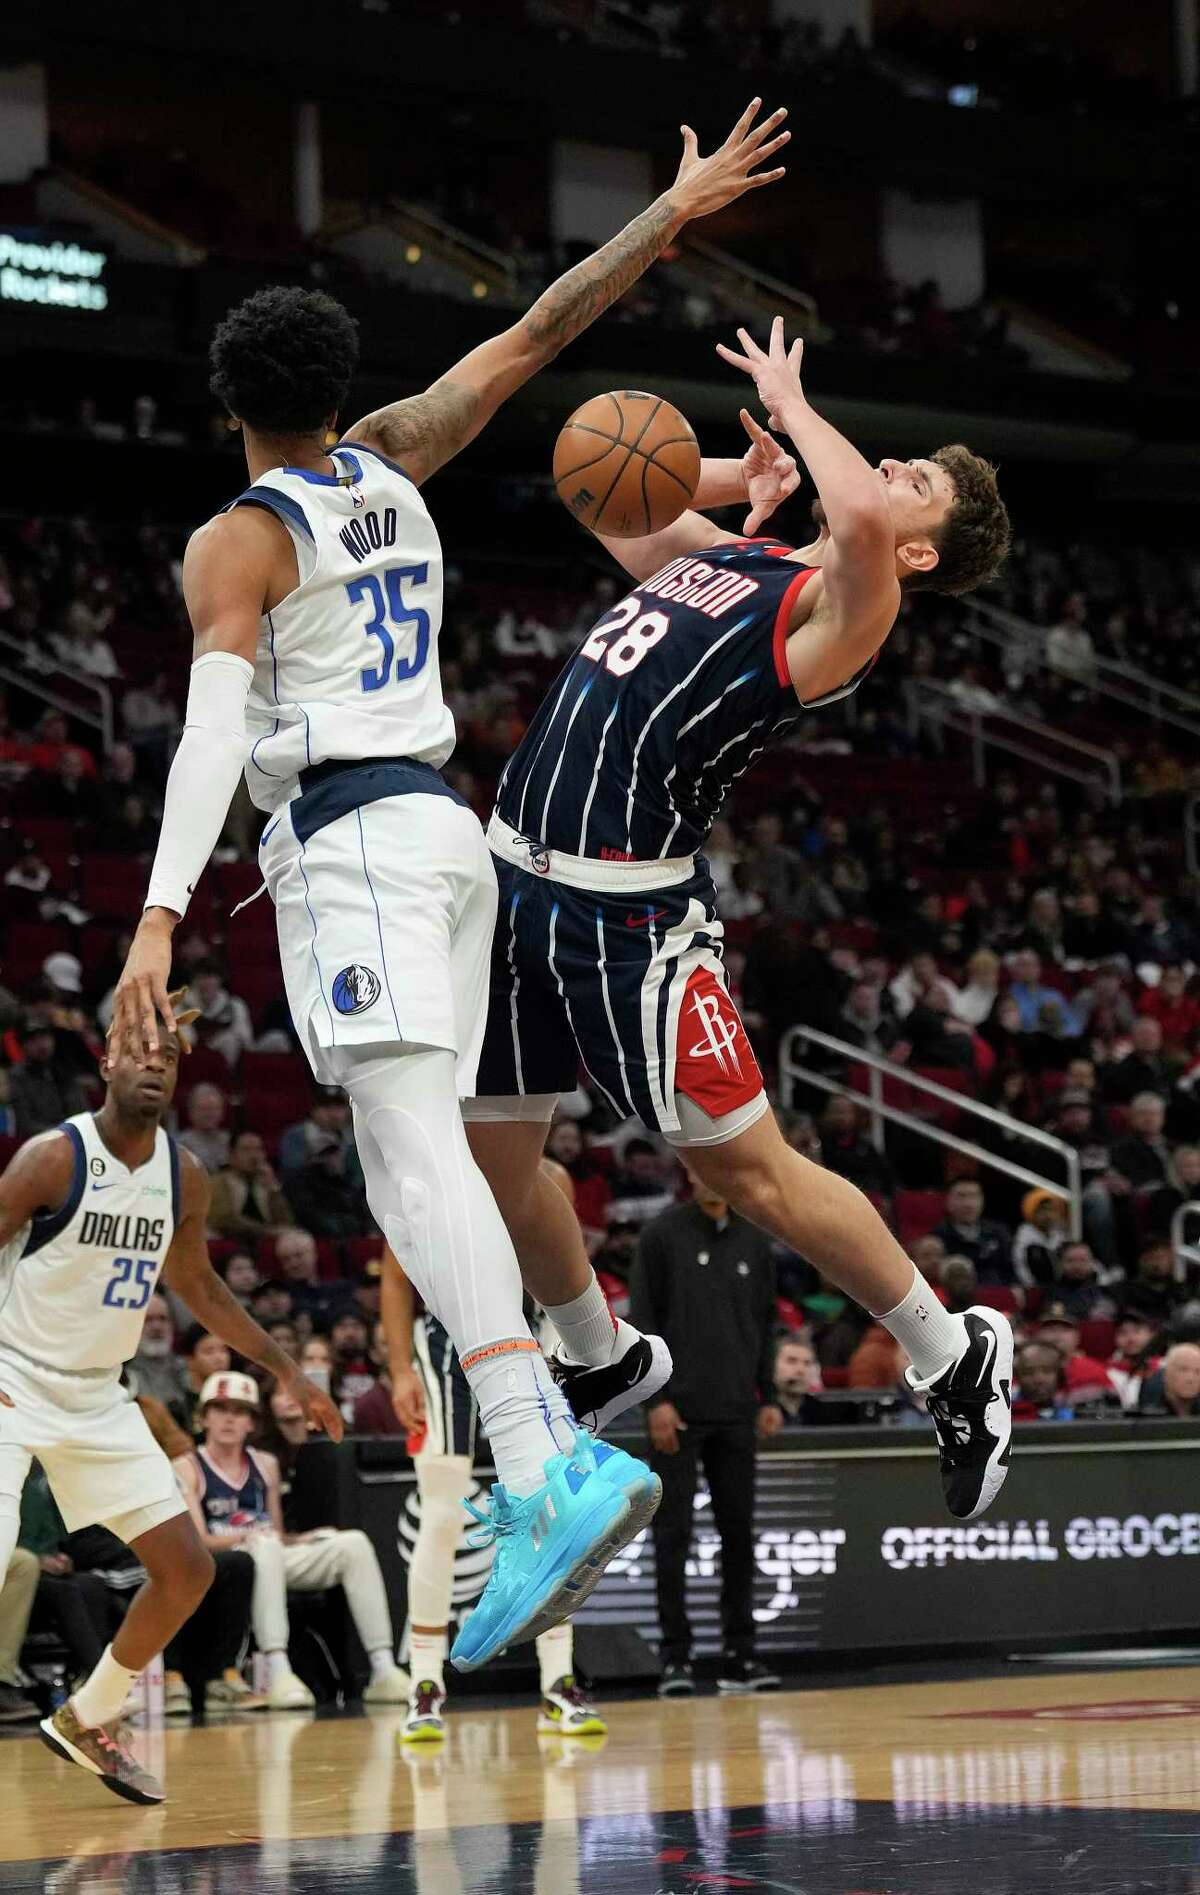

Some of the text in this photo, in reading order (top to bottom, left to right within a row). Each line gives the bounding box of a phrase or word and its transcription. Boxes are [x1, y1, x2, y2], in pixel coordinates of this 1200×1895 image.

[339, 507, 397, 563] WOOD
[631, 556, 760, 619] OUSTON
[344, 560, 430, 694] 35
[580, 595, 671, 677] 28
[78, 1211, 165, 1252] DALLAS
[102, 1257, 157, 1310] 25
[881, 1519, 1059, 1569] OFFICIAL
